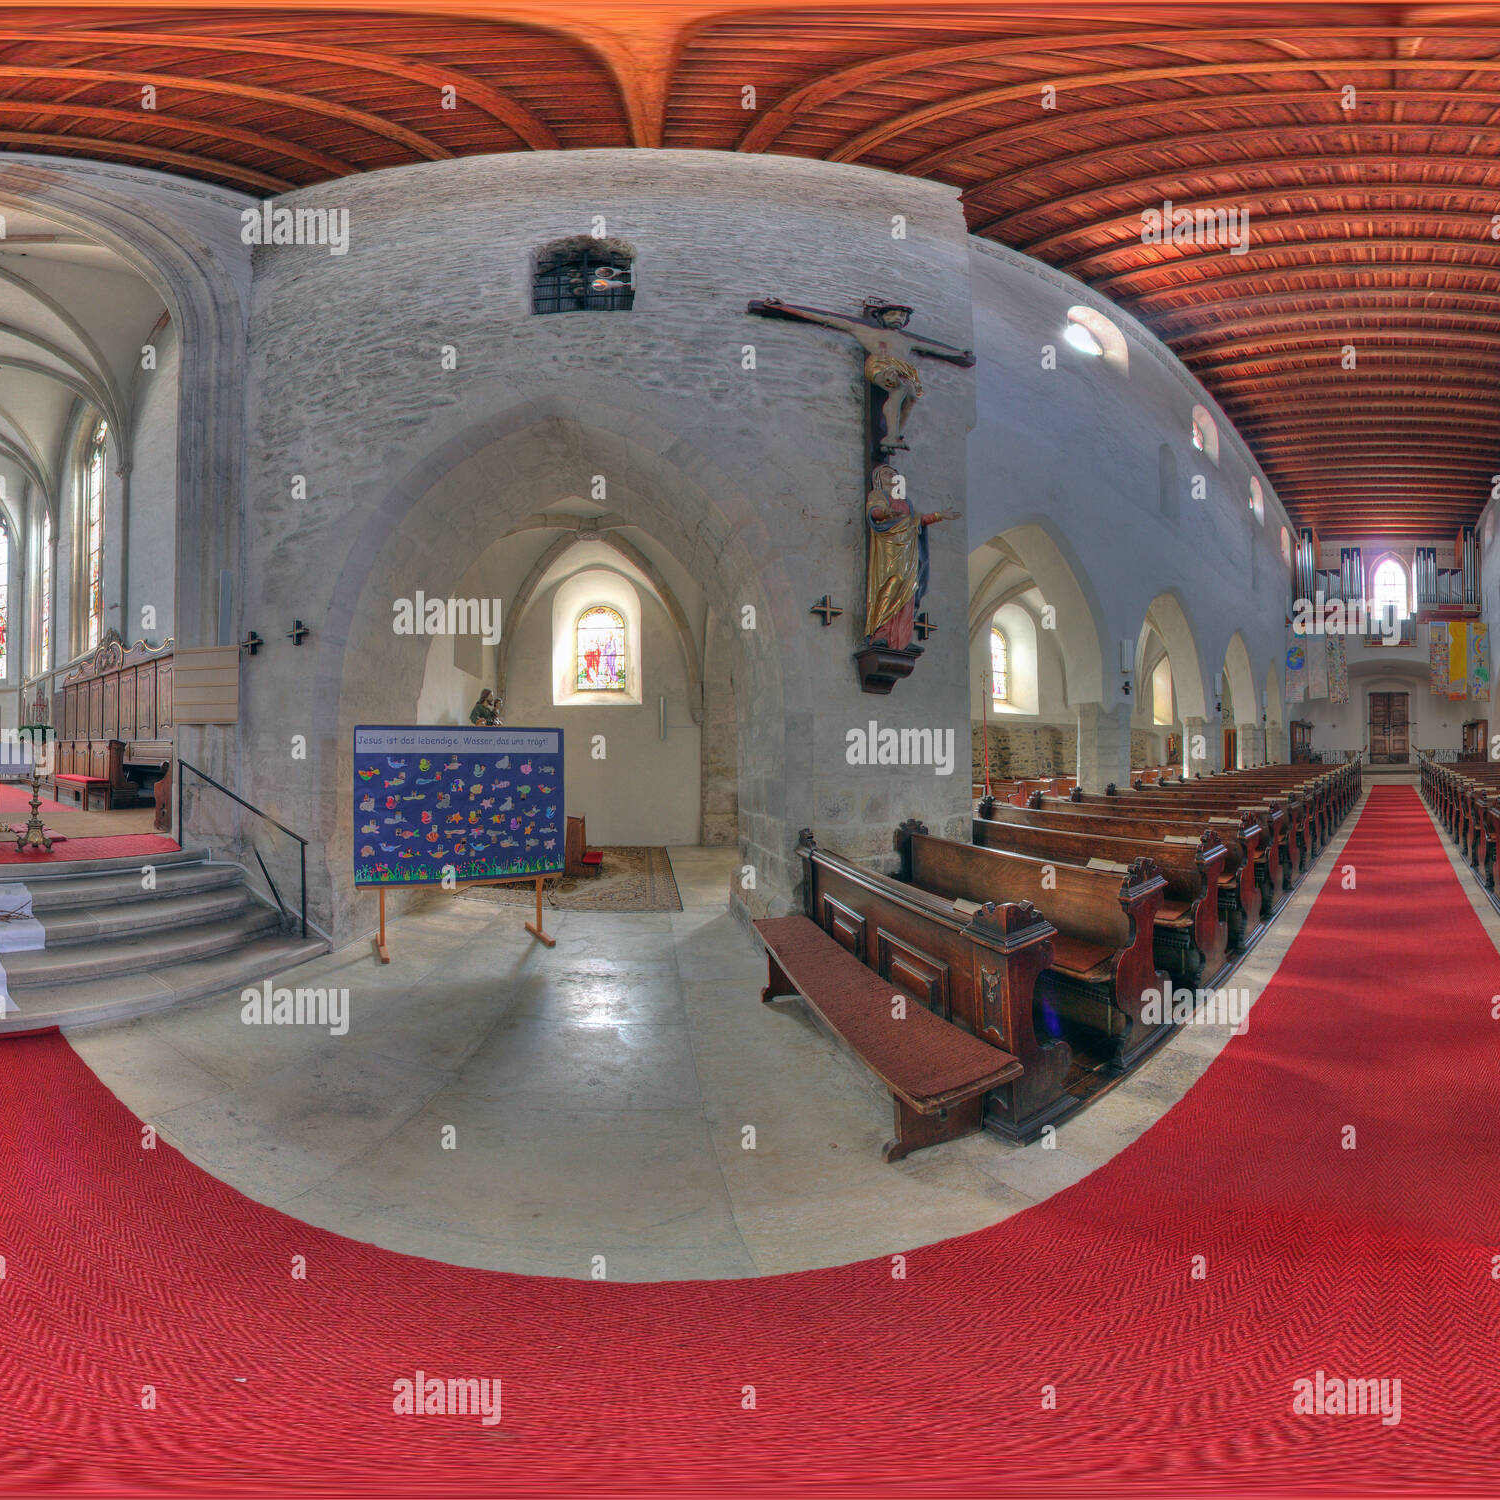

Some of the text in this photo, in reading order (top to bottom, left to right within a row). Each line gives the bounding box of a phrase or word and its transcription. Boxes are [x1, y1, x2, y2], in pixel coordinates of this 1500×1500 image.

[358, 736, 382, 745] Jesus
[386, 736, 397, 745] ist
[401, 736, 415, 745] das
[418, 736, 458, 747] lebendige
[496, 737, 509, 745] das
